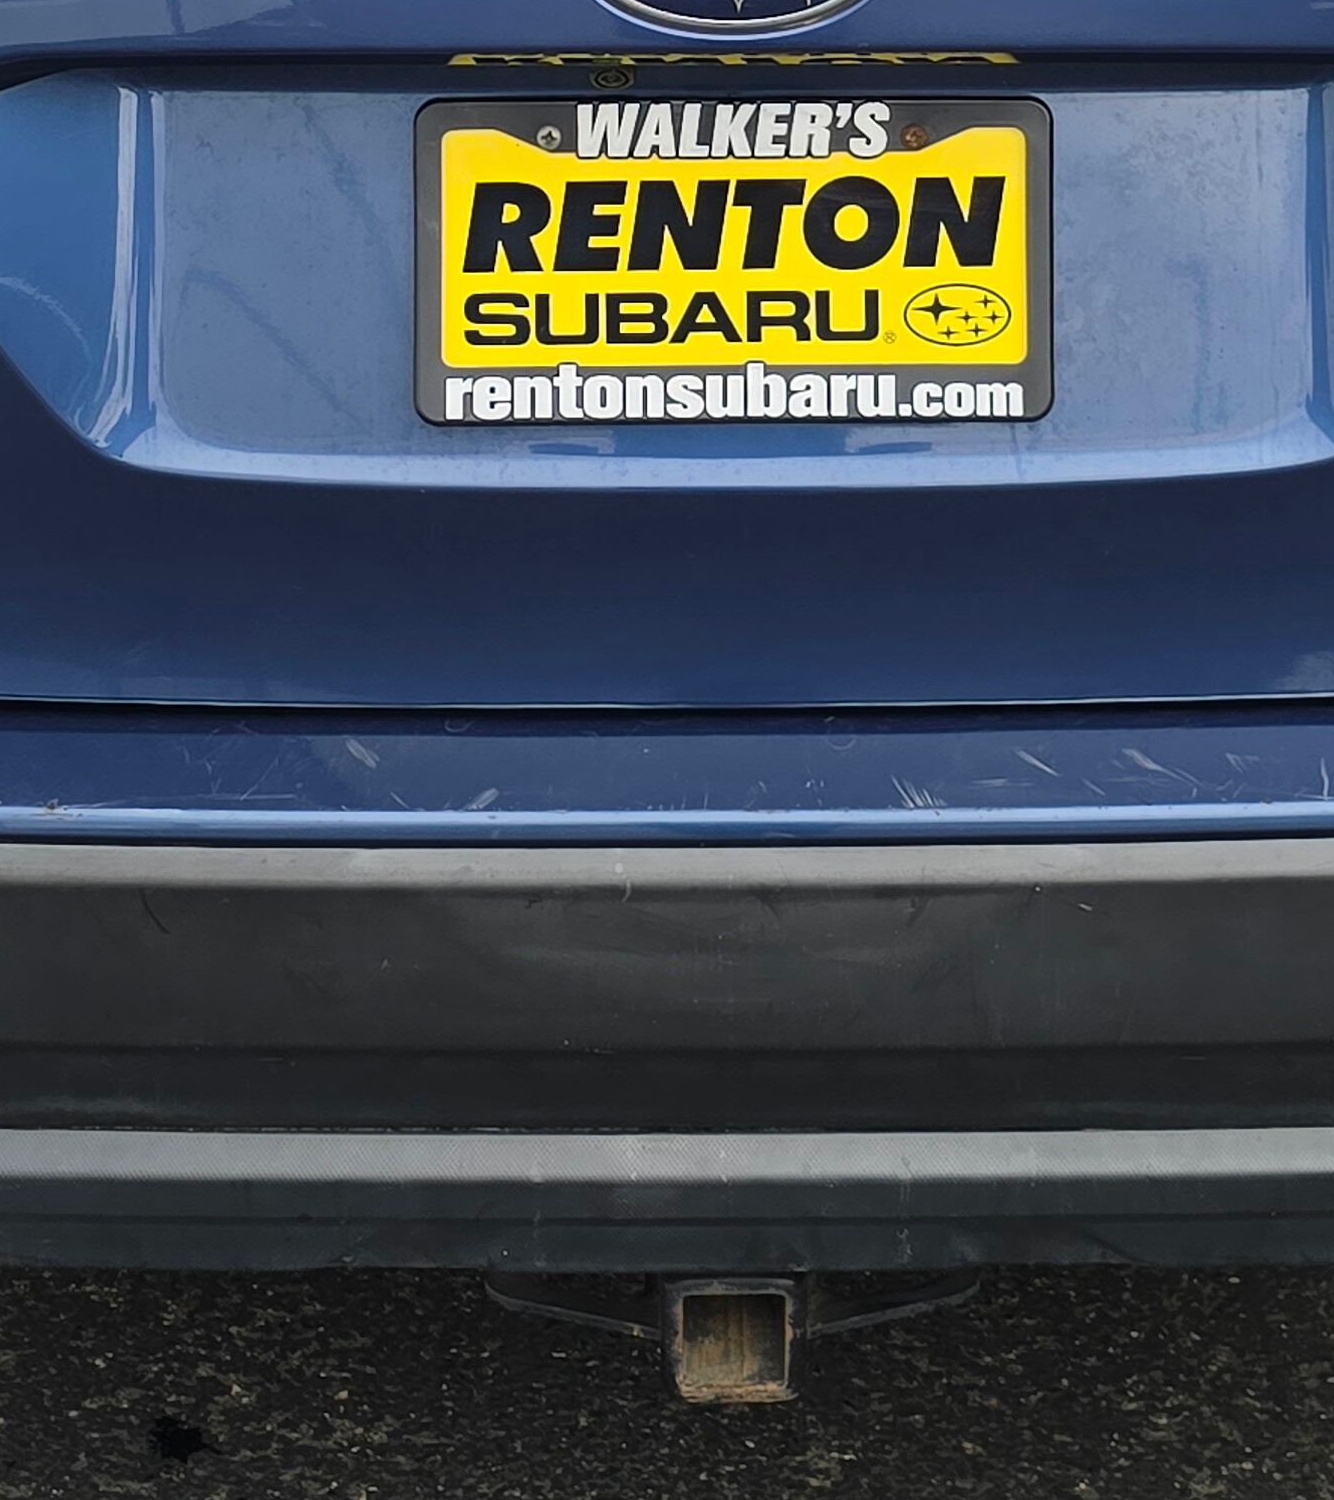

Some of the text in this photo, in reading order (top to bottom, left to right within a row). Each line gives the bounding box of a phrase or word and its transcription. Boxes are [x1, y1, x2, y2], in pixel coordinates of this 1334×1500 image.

[575, 102, 889, 159] WALKER'S
[462, 176, 1006, 274] RENTON
[464, 289, 880, 345] SUBARU
[444, 362, 1023, 420] rentonsubaru.com
